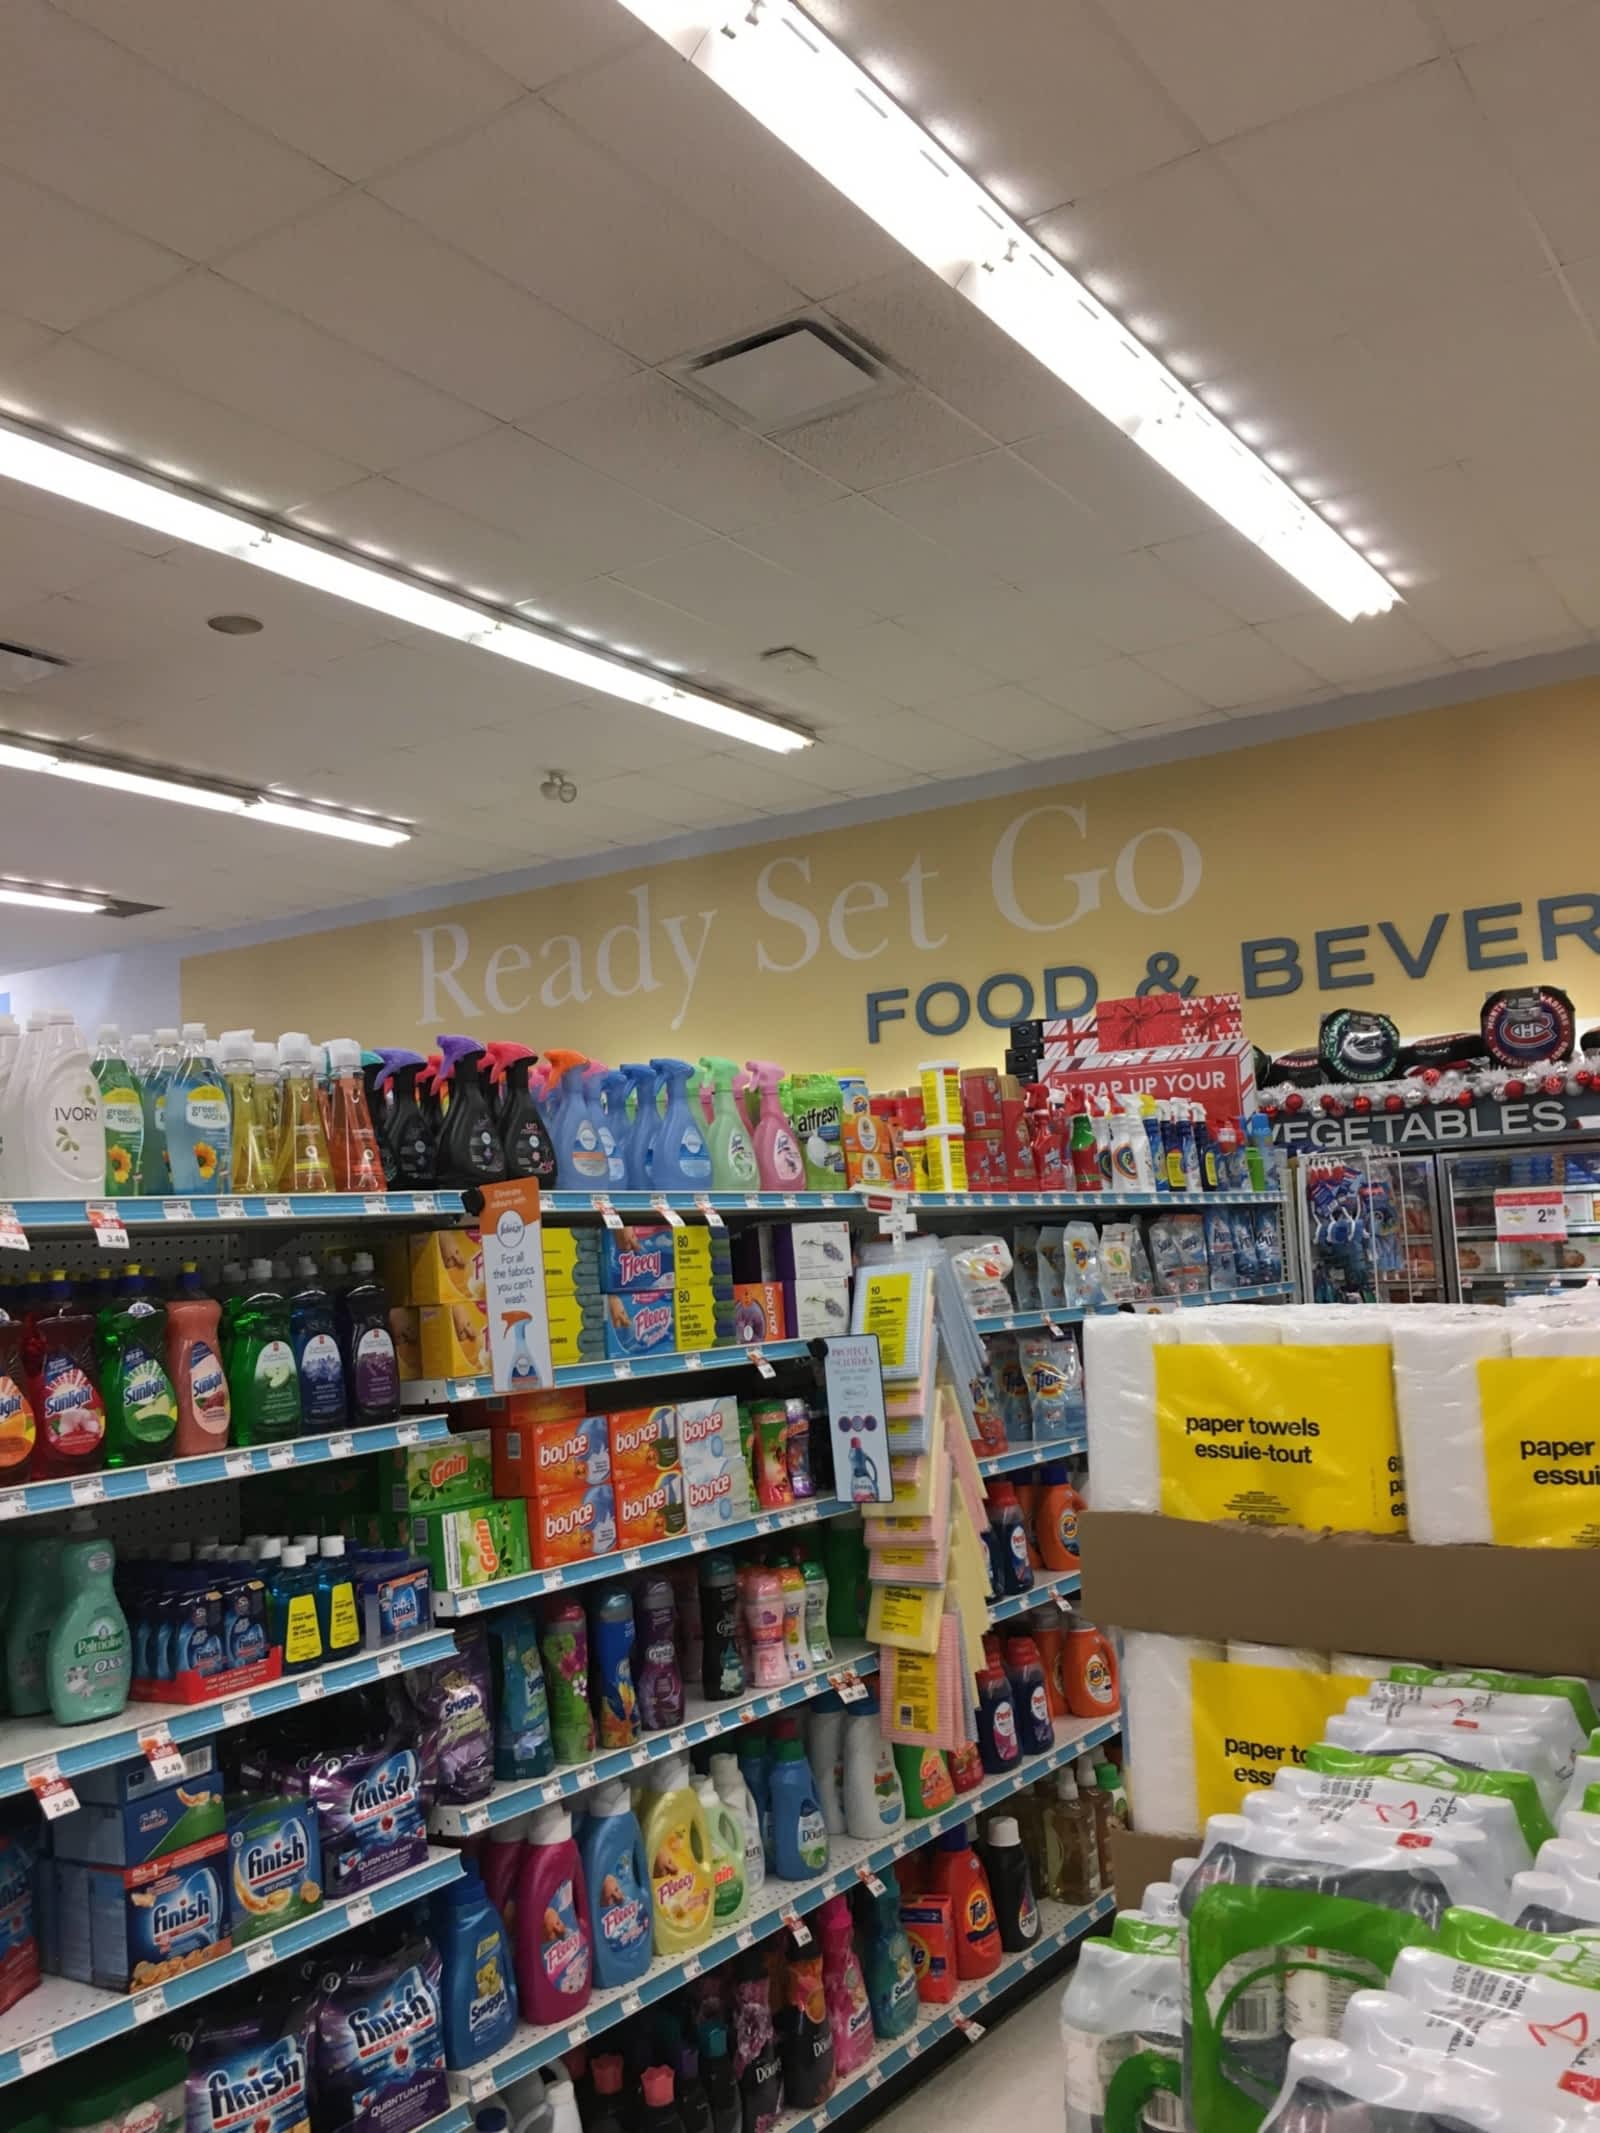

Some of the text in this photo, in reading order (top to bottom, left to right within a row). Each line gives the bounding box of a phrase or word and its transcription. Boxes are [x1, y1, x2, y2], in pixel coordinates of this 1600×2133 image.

[414, 802, 1203, 1030] Ready Set Go
[866, 892, 1600, 1044] FOOD & BEVER
[1129, 1077, 1158, 1095] UP
[1163, 1071, 1226, 1093] YOUR
[54, 1106, 98, 1122] IVORY
[798, 1105, 839, 1134] affresh
[677, 1235, 689, 1248] 80
[493, 1270, 506, 1280] the
[508, 1266, 535, 1277] fabrics
[501, 1254, 514, 1265] For
[619, 1250, 662, 1285] Fleecy
[496, 1284, 512, 1295] you
[678, 1290, 690, 1303] 80
[871, 1286, 881, 1295] 10
[635, 1306, 672, 1335] Fleecy
[124, 1378, 167, 1405] Sunlight
[193, 1372, 223, 1396] Sunlight
[45, 1387, 92, 1416] Sunlight
[615, 1419, 660, 1453] bounce
[683, 1413, 721, 1442] bounce
[1185, 1416, 1320, 1437] paper towels
[540, 1433, 589, 1468] bounce
[1194, 1441, 1313, 1463] essuie-tout
[1520, 1440, 1596, 1461] paper
[430, 1454, 468, 1488] Gain
[622, 1488, 666, 1521] bounce
[689, 1474, 731, 1506] bounce
[545, 1503, 594, 1539] bounce
[474, 1518, 499, 1573] Gain
[1225, 1737, 1286, 1764] paper
[163, 1762, 182, 1774] 2.49
[39, 1781, 65, 1796] Sale
[351, 1766, 411, 1816] finish
[53, 1798, 75, 1812] 2.49
[248, 1836, 305, 1880] finish
[357, 1847, 399, 1871] QUANTUM
[656, 1873, 694, 1905] Fleecy
[714, 1866, 735, 1884] ain
[153, 1891, 210, 1935] finish
[602, 1902, 637, 1936] Fleecy
[969, 1900, 990, 1925] Tide
[911, 1943, 925, 1965] de
[348, 1985, 432, 2048] finish
[208, 2055, 303, 2119] finish
[369, 2084, 419, 2119] QUANTUM
